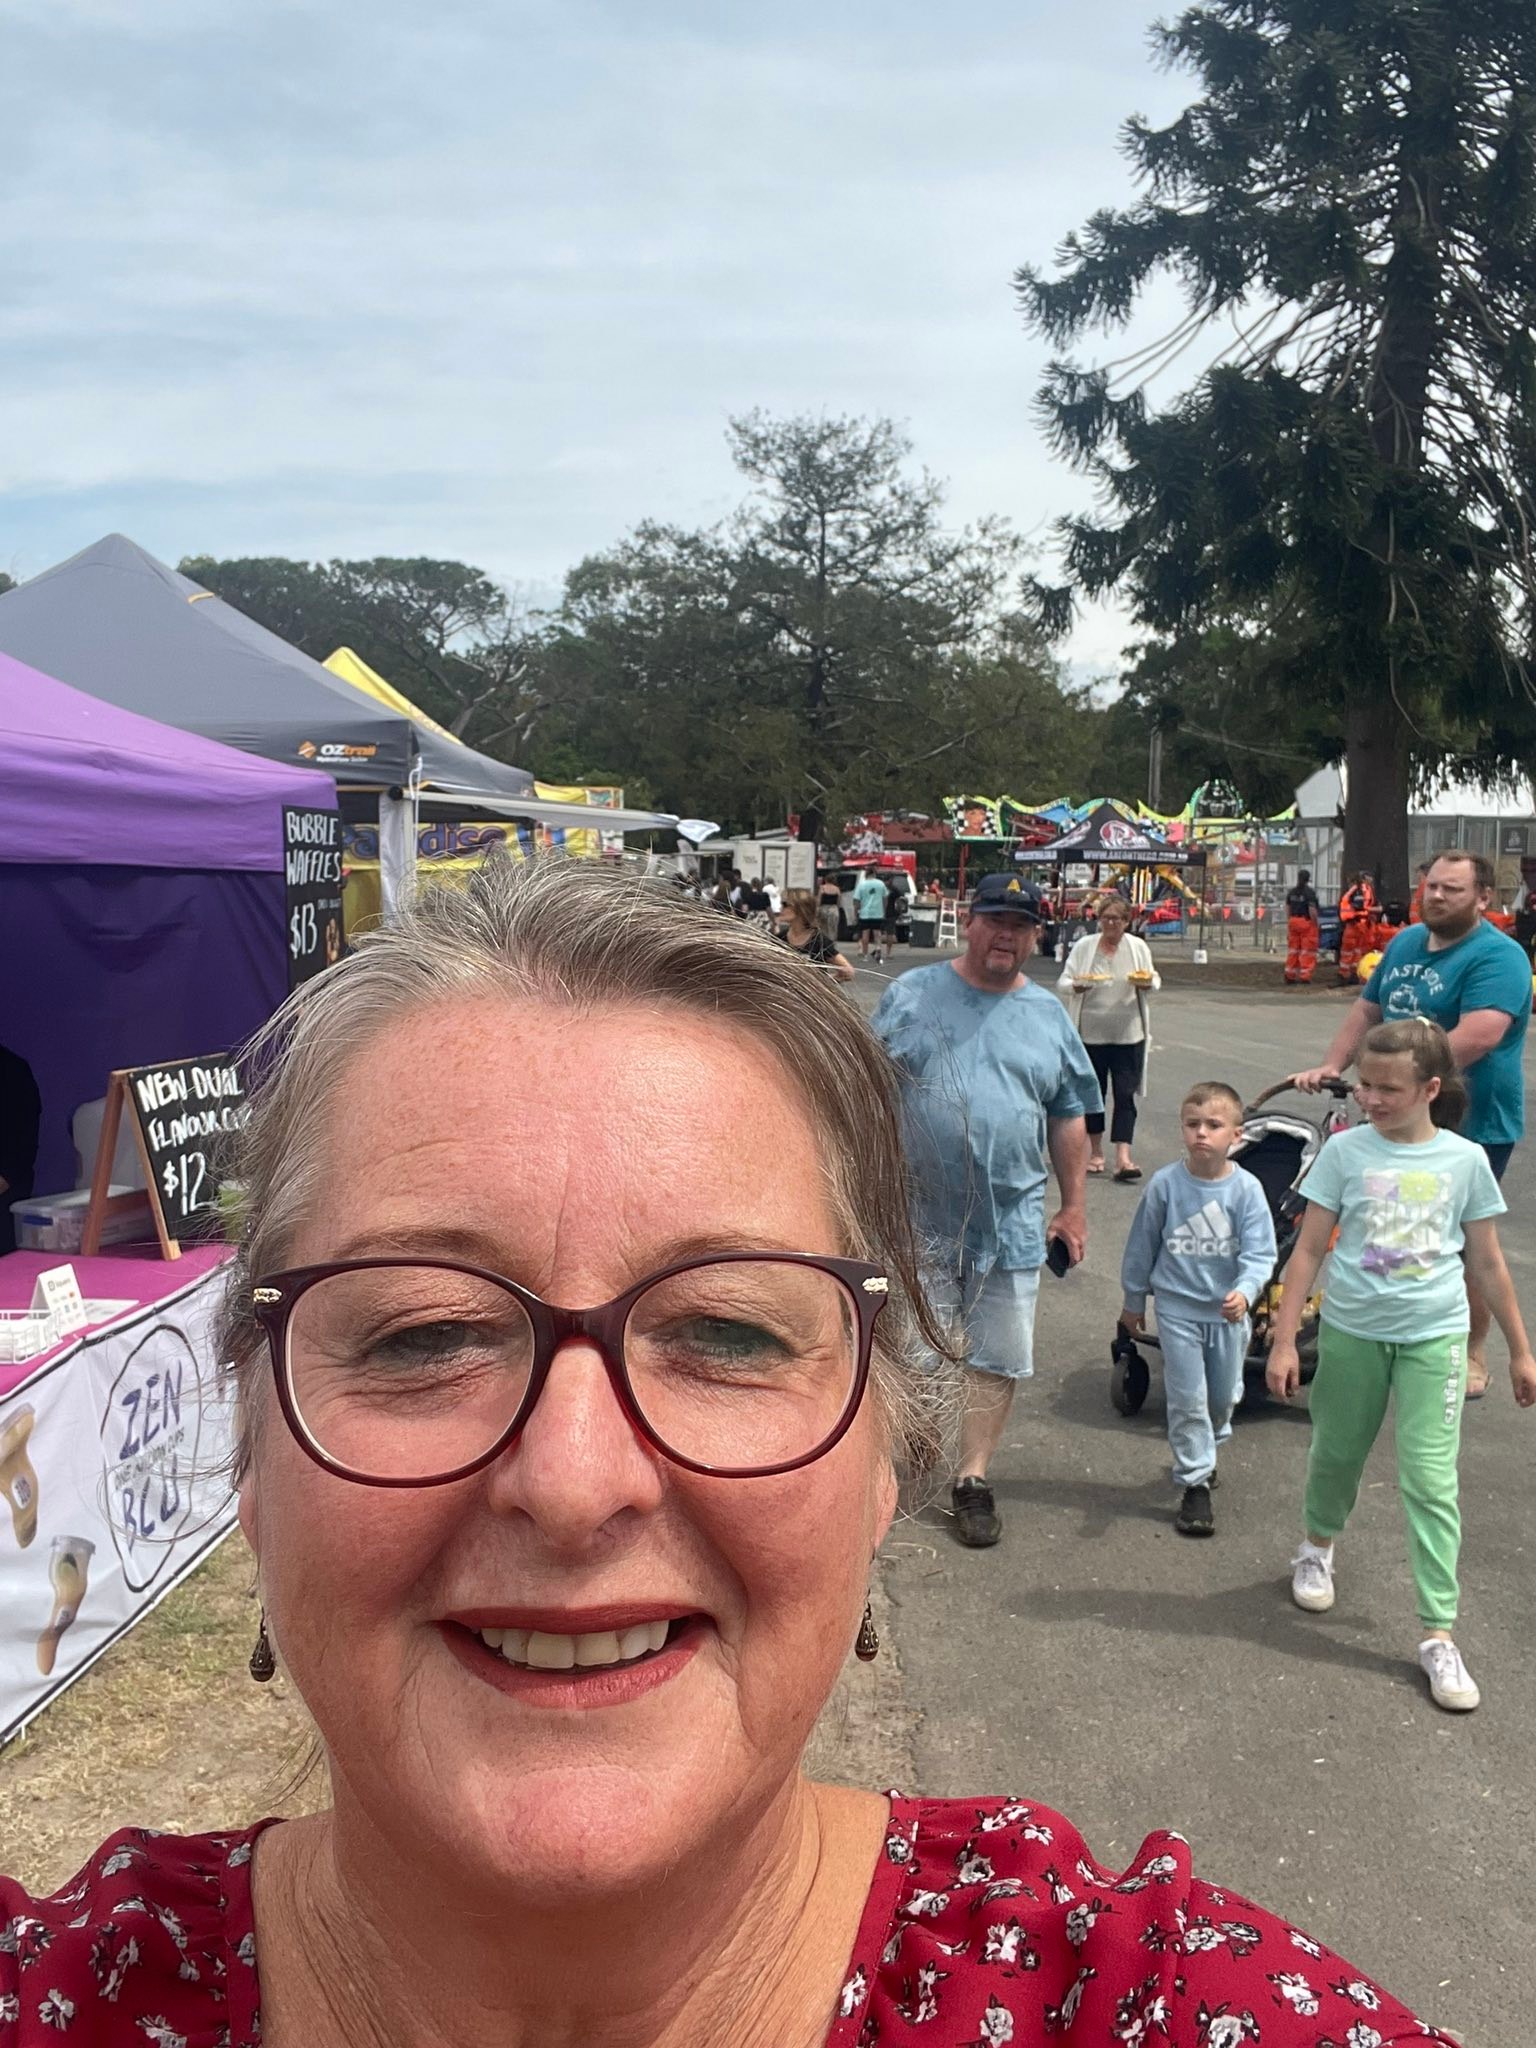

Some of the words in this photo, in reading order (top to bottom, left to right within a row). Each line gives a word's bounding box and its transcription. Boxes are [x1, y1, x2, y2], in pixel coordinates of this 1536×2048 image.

[286, 811, 339, 846] BUBBLE
[286, 849, 342, 886] WAFFLES
[290, 902, 318, 960] $13
[137, 1069, 188, 1113] NEW
[191, 1066, 244, 1099] DUAL
[163, 1151, 217, 1216] $12
[120, 1359, 182, 1460] ZEN
